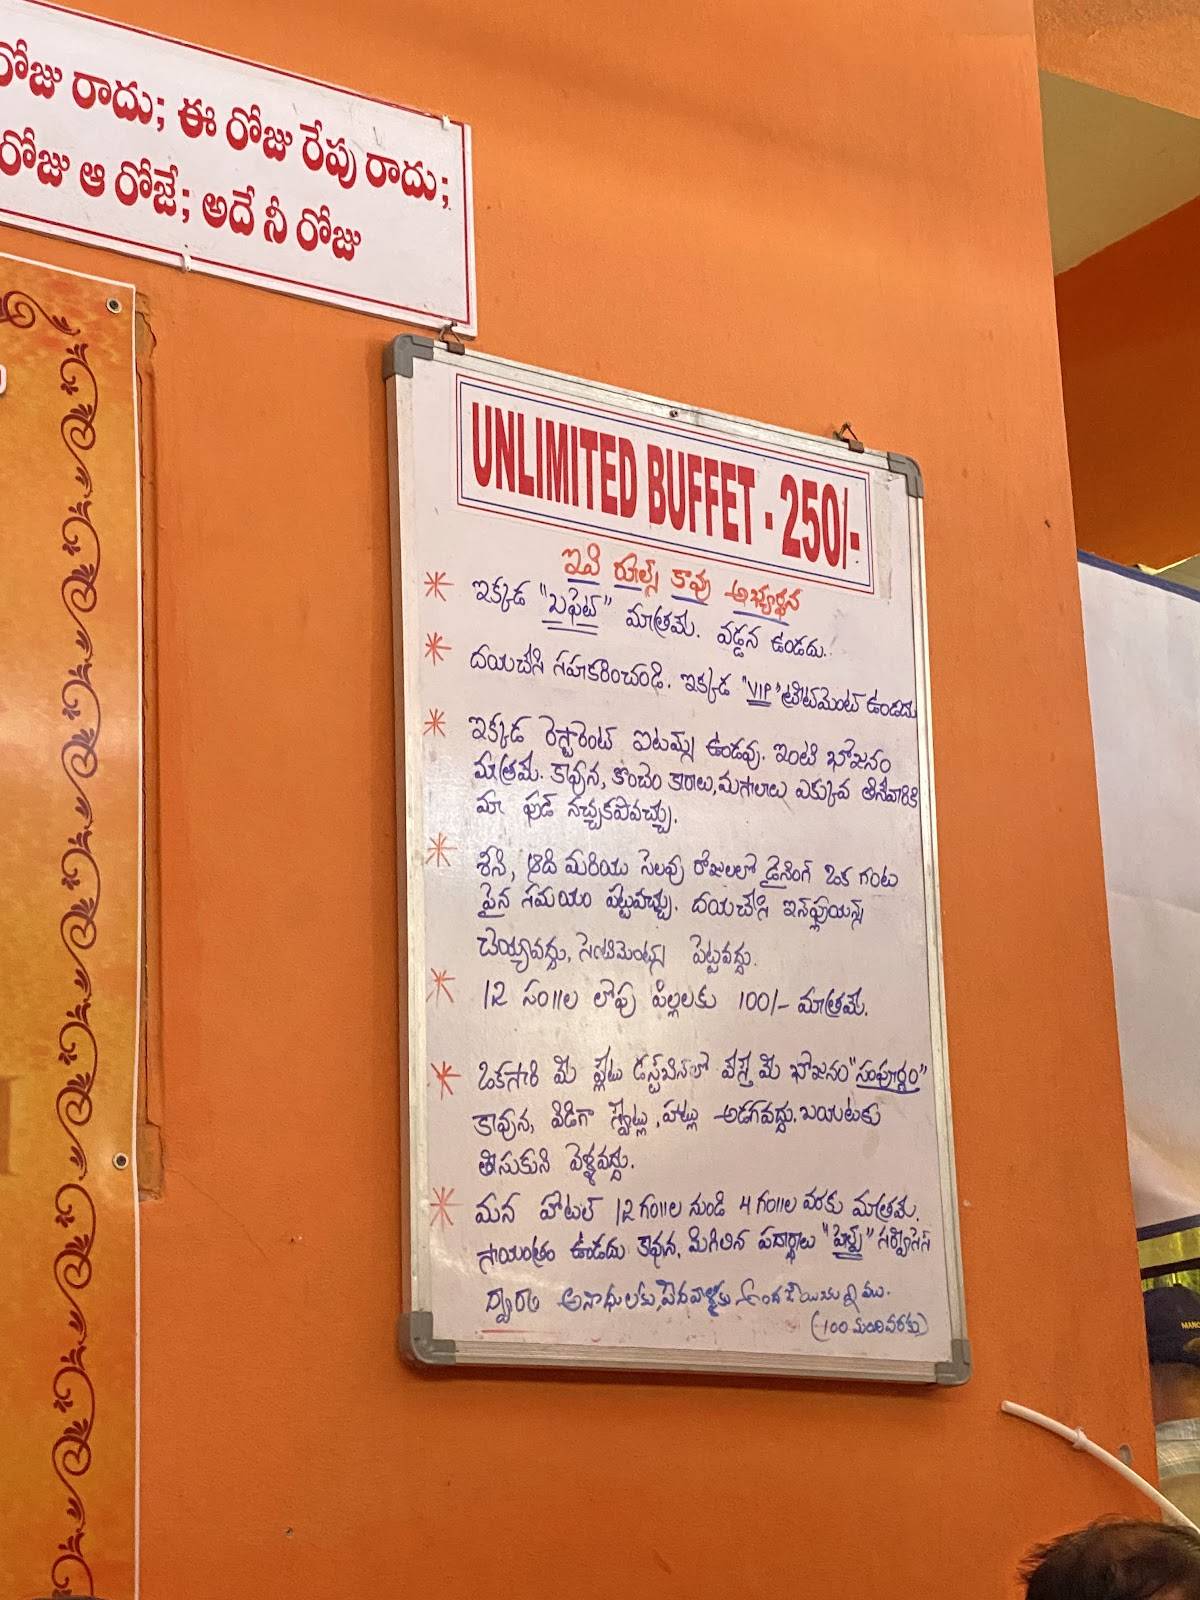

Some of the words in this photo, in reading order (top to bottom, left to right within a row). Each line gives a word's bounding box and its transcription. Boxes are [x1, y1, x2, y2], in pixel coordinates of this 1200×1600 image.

[0, 38, 62, 98] రోజు
[72, 71, 165, 132] రాదు;
[178, 97, 217, 138] ఈ
[226, 103, 293, 162] రోజు
[300, 119, 357, 190] రేపు
[365, 151, 450, 208] రాదు;
[0, 127, 70, 188] రోజు
[79, 161, 106, 197] ఆ
[115, 157, 191, 224] రోజే;
[202, 185, 256, 236] అదే
[264, 195, 288, 243] నీ
[296, 204, 362, 261] రోజు
[472, 402, 637, 518] UNLIMITED
[647, 444, 755, 545] BUFFET
[780, 474, 860, 569] 250/-
[562, 543, 600, 575] ఇవి
[671, 568, 712, 602] కావు
[472, 576, 531, 612] ఇక్కడ
[626, 603, 700, 638] మాత్రమే.
[717, 621, 759, 657] వడ్డన
[470, 643, 544, 675] దయచేసి
[553, 650, 672, 690] సహకరించండి.
[681, 667, 732, 703] ఇక్కడ
[469, 712, 532, 749] ఇక్కడ
[706, 731, 766, 770] ఉండవు.
[773, 740, 818, 767] ఇంటి
[827, 738, 892, 774] భోజనం
[476, 789, 505, 815] మా
[523, 791, 558, 828] ఫుడ్
[551, 760, 607, 796] కావున,
[612, 762, 662, 790] కొంచెం
[796, 778, 850, 808] ఎక్కువ
[527, 848, 558, 883] ఆది
[565, 849, 629, 877] మరియు
[639, 848, 685, 886] సెలవు
[694, 849, 757, 880] రోజులలో
[825, 864, 853, 887] ఒక
[477, 882, 511, 918] పైన
[521, 882, 592, 909] సమయం
[691, 888, 769, 921] దయచేసి
[484, 979, 508, 1010] 12
[593, 979, 637, 1019] లోపు
[651, 979, 717, 1017] పిల్లలకు
[738, 988, 790, 1017] 100/-
[797, 986, 868, 1018] మాత్రమే.
[478, 1060, 539, 1093] ఒకసారి
[553, 1055, 577, 1085] మీ
[593, 1046, 623, 1093] ప్లేటు
[721, 1048, 754, 1088] వేస్తే
[759, 1053, 781, 1081] మీ
[790, 1050, 848, 1085] భోజనం
[472, 1107, 535, 1142] కావున,
[551, 1100, 595, 1130] విడిగా
[799, 1097, 881, 1127] బయటకు
[475, 1192, 521, 1224] మన
[539, 1190, 604, 1222] హోటల్
[689, 1190, 726, 1217] నుండి
[803, 1186, 844, 1215] వరకు
[477, 1235, 556, 1275] సాయంత్రం
[570, 1231, 626, 1261] ఉండదు
[688, 1225, 750, 1253] మిగిలిన
